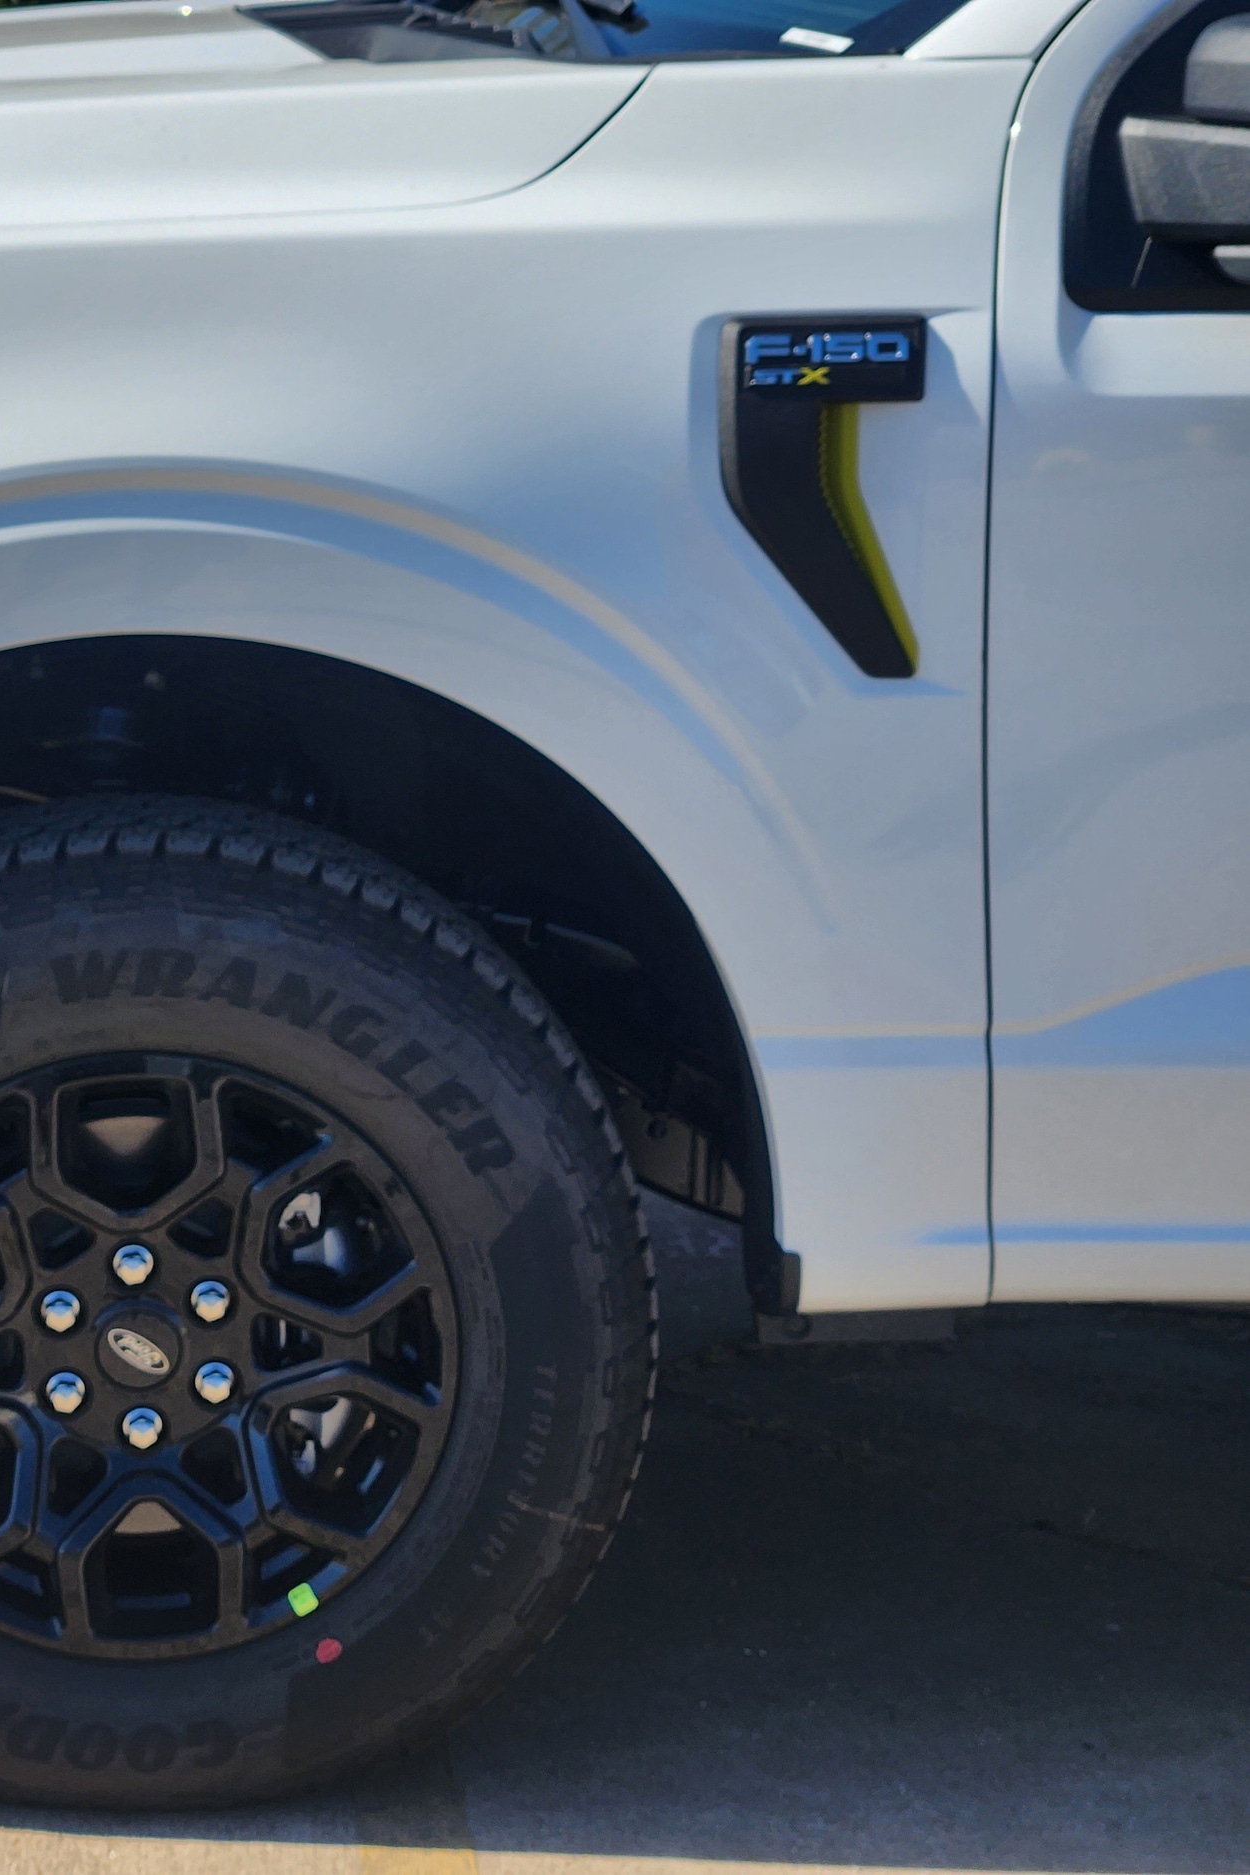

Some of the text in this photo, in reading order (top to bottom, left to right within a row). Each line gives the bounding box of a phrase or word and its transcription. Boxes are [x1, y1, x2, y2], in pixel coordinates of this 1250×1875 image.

[745, 331, 910, 365] F-150
[750, 366, 831, 386] STX
[50, 948, 515, 1177] WRANGLER
